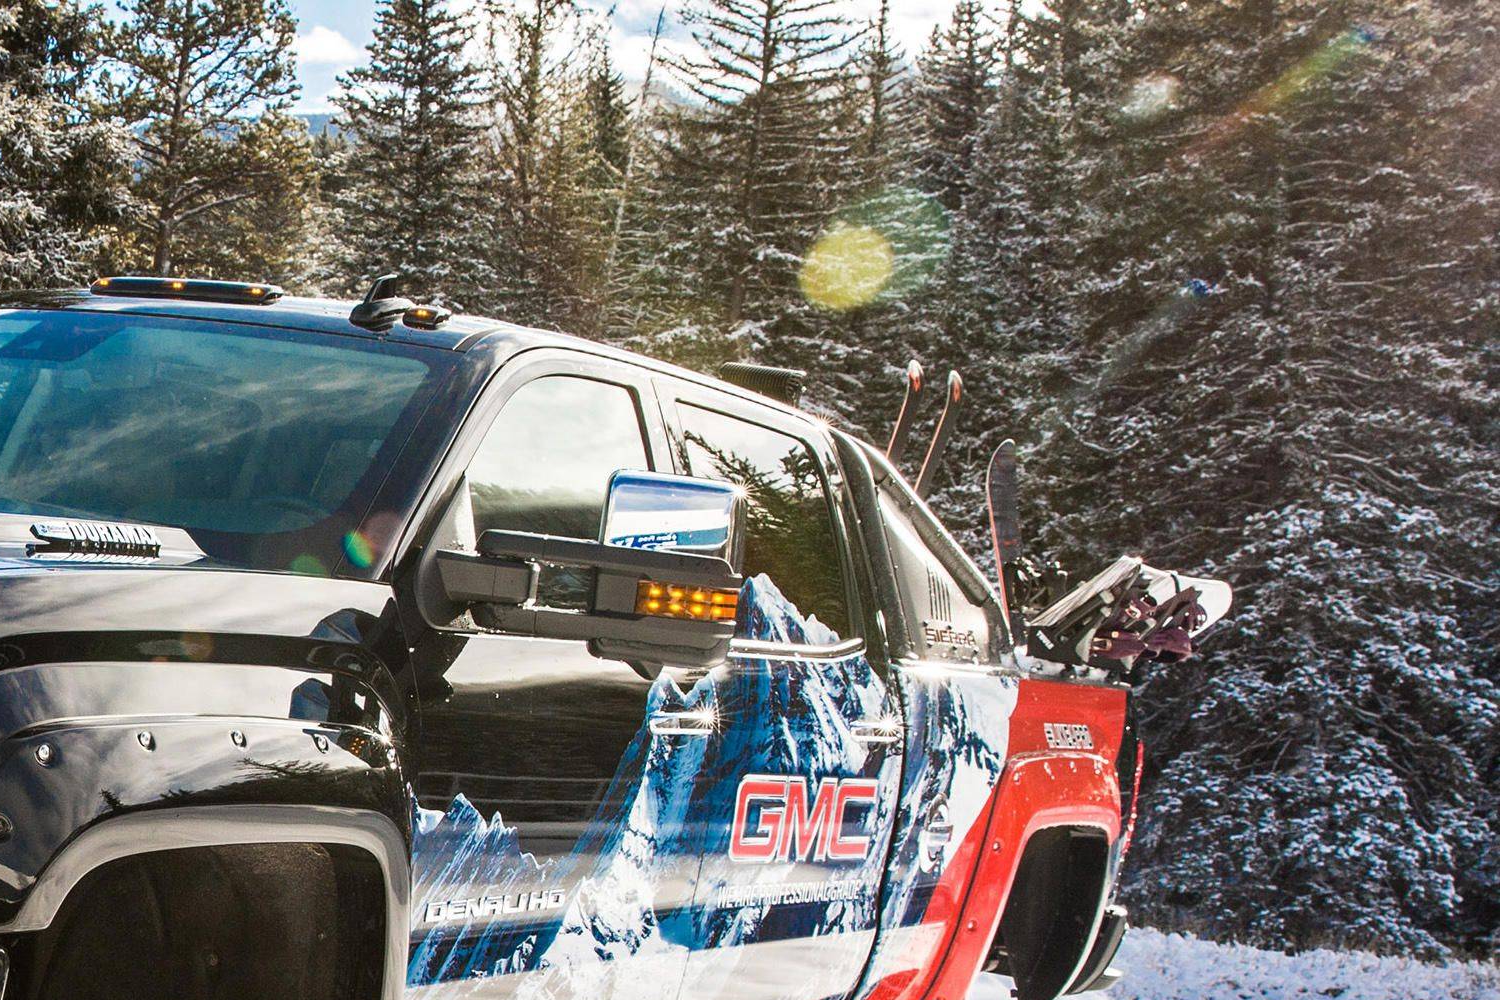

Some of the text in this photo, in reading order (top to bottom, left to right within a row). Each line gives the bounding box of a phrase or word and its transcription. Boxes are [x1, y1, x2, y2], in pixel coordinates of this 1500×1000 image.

[67, 521, 161, 547] DURAMAX
[924, 627, 977, 646] SIERRA
[729, 774, 879, 863] GMC
[424, 888, 565, 923] DENALI HD
[717, 879, 860, 908] WE ARE PROFESSIONAL GRADE
